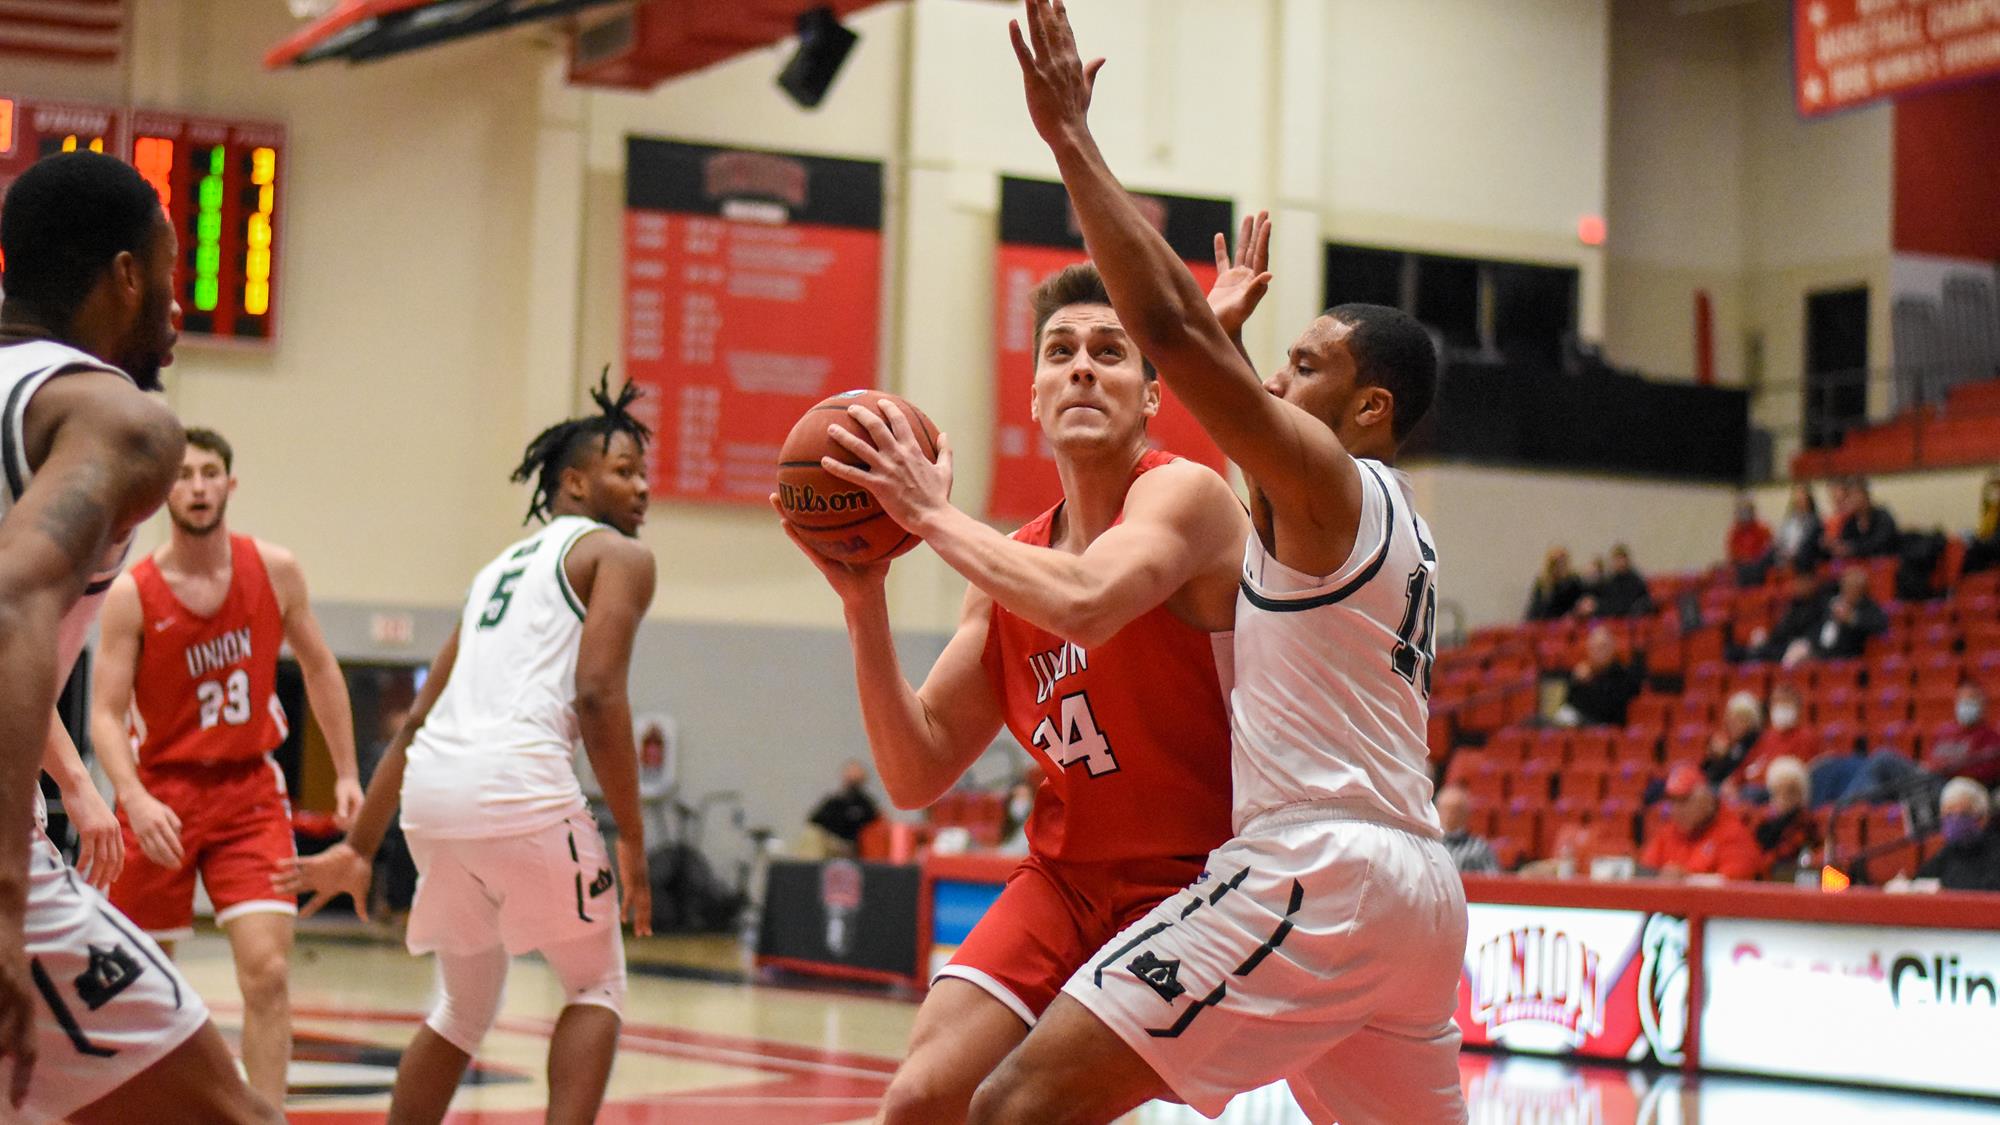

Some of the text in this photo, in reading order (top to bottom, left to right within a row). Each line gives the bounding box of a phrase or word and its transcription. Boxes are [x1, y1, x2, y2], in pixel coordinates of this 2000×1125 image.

[779, 481, 873, 513] Wilson
[478, 567, 525, 628] 5
[185, 624, 252, 679] UNION
[197, 669, 252, 729] 23
[1472, 925, 1605, 1038] UNION
